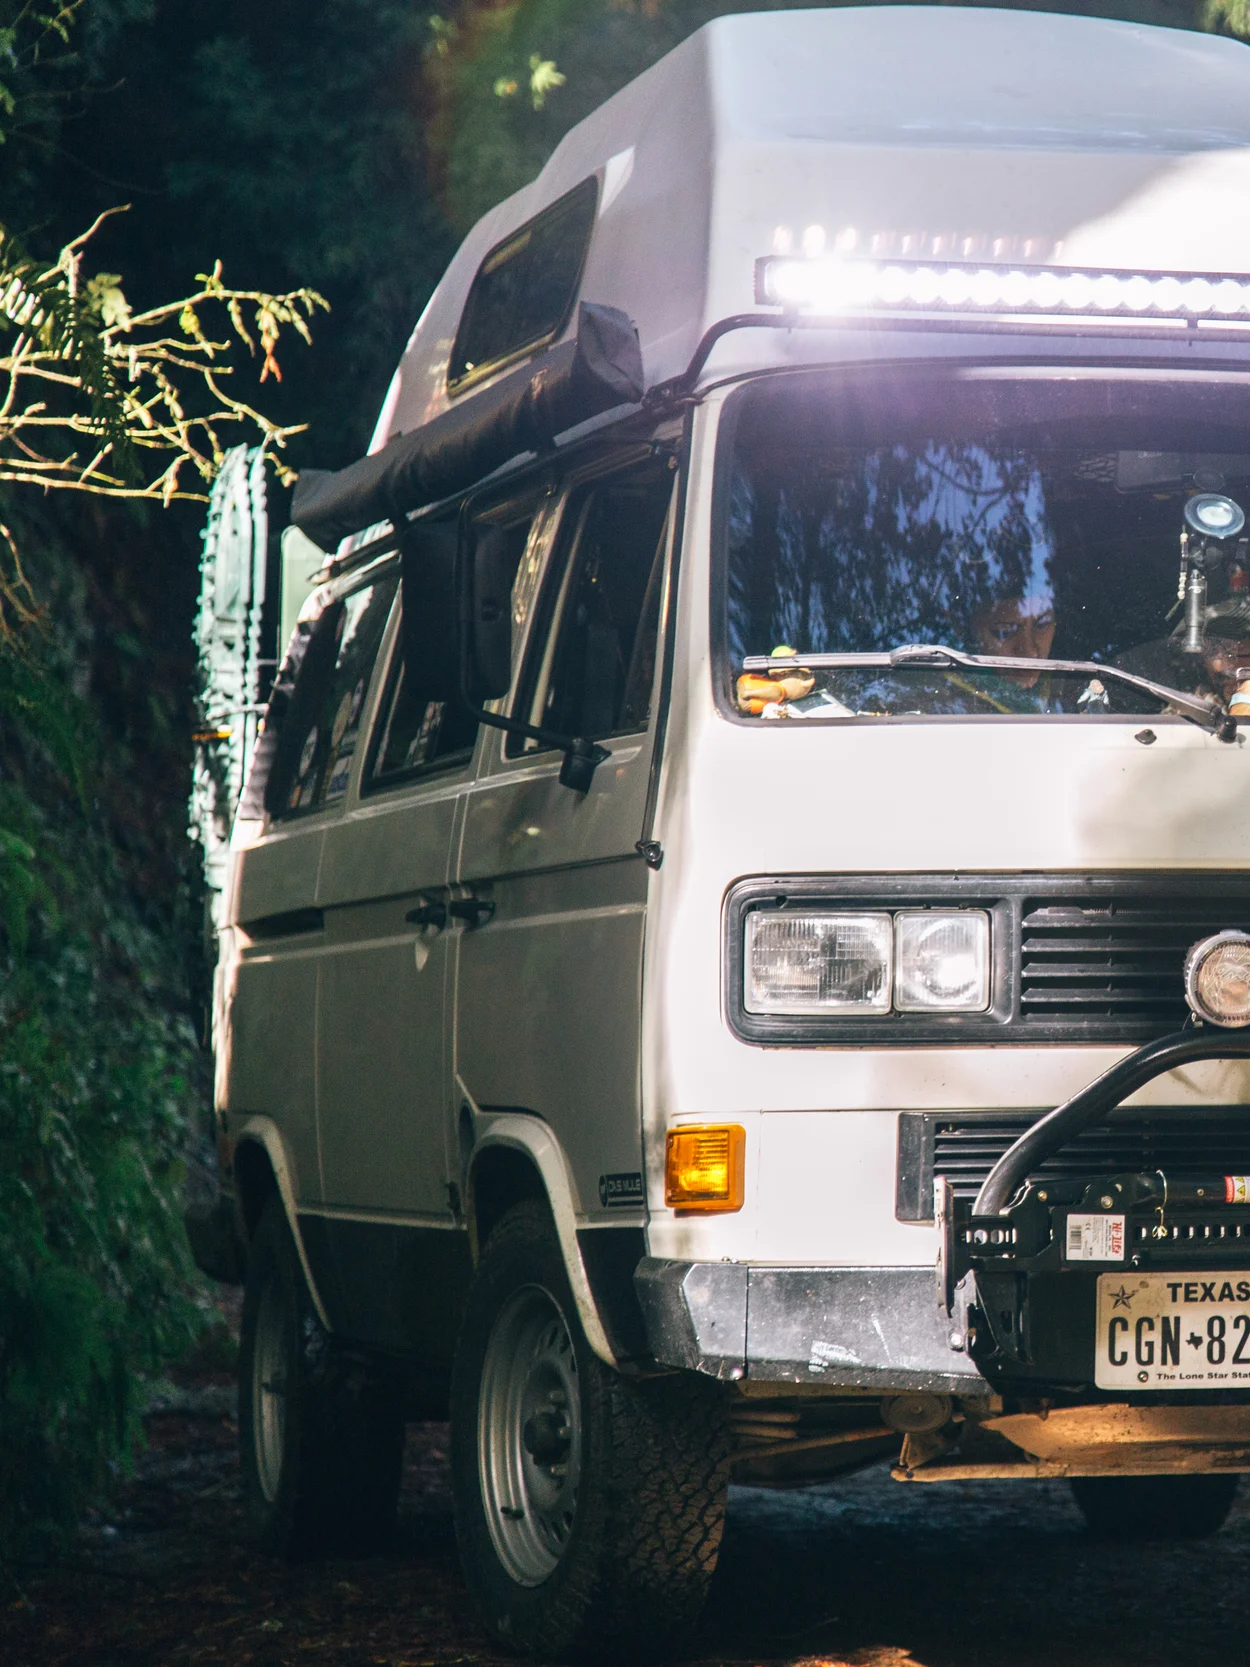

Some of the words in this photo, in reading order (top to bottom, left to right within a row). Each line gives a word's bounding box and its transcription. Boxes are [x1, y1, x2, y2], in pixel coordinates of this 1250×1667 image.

[1166, 1281, 1250, 1303] TEXAS
[1107, 1316, 1181, 1367] CGN
[1179, 1372, 1204, 1380] Lone
